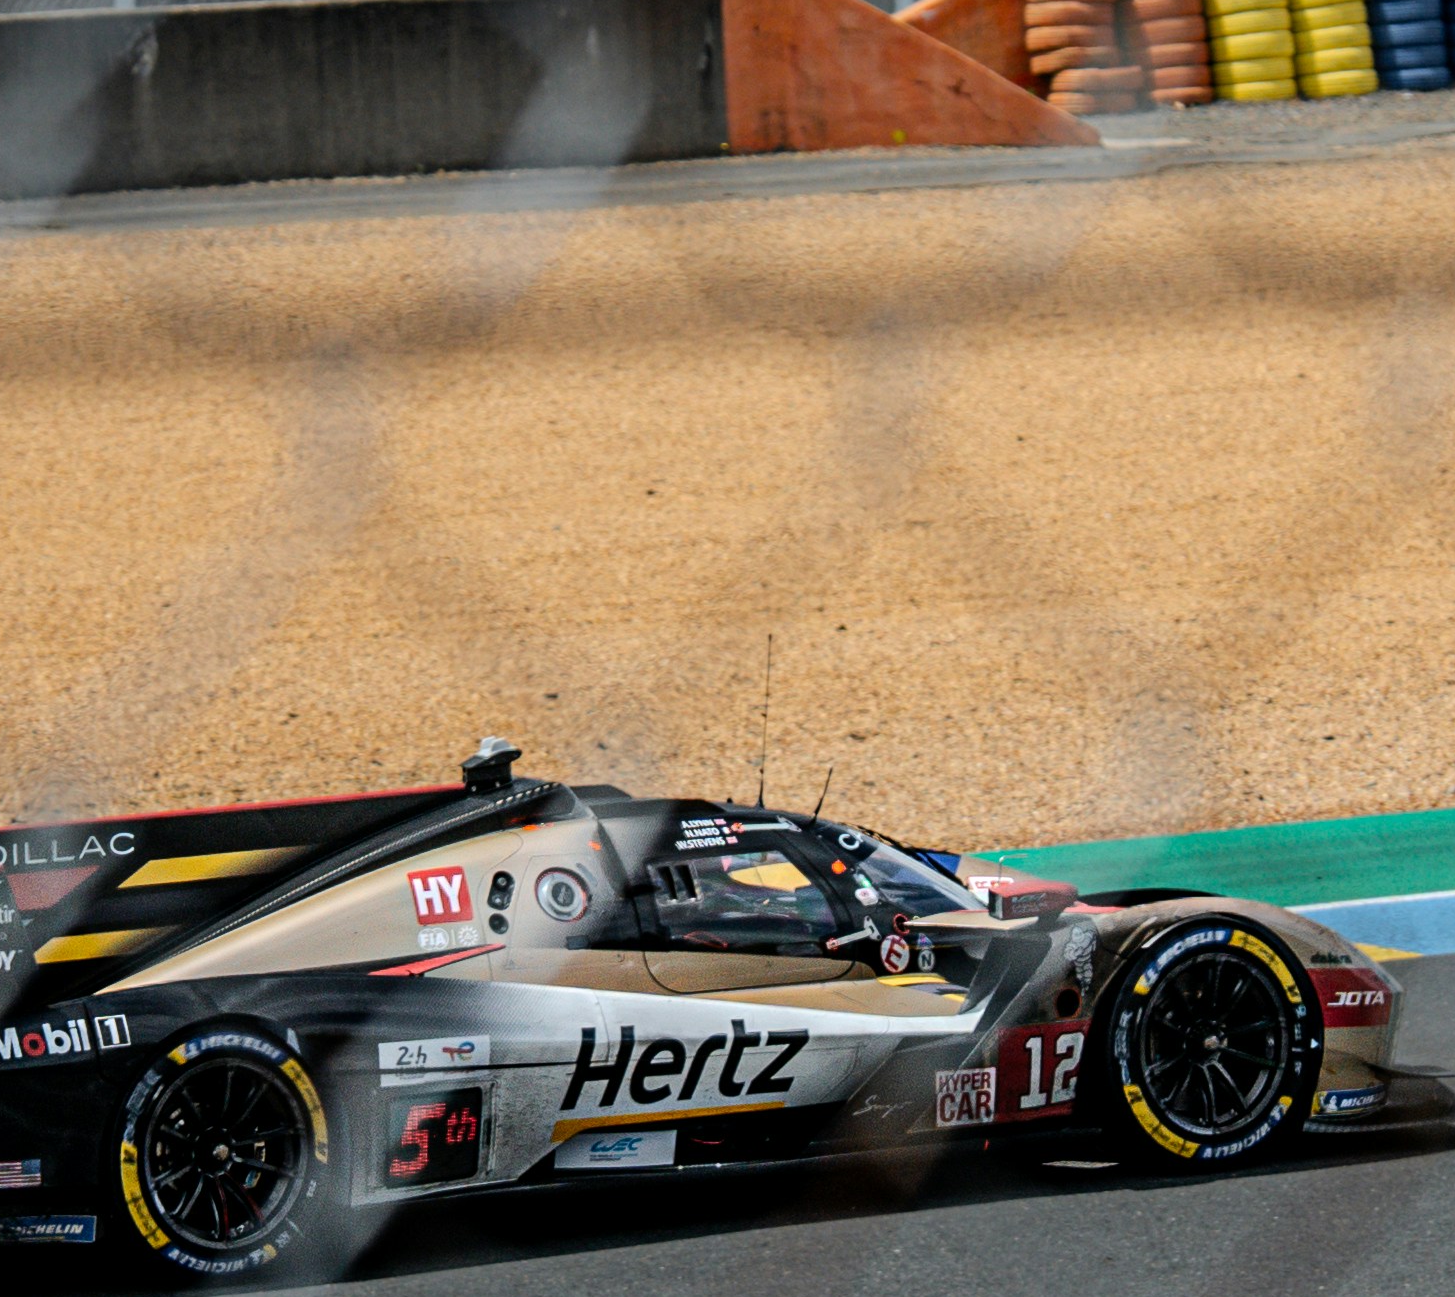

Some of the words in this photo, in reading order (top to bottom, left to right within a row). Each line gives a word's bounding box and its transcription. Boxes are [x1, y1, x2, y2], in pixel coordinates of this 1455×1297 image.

[412, 874, 462, 916] HY
[420, 933, 445, 947] FIA
[885, 937, 908, 971] E
[1327, 990, 1385, 1006] JOTA
[104, 1017, 121, 1045] 1
[200, 1034, 281, 1059] MICHELIN
[560, 1019, 809, 1111] Hertz
[1020, 1032, 1085, 1110] 12
[939, 1071, 991, 1093] HYPER
[939, 1090, 992, 1123] CAR
[389, 1103, 478, 1177] 5th
[591, 1137, 644, 1152] WEC
